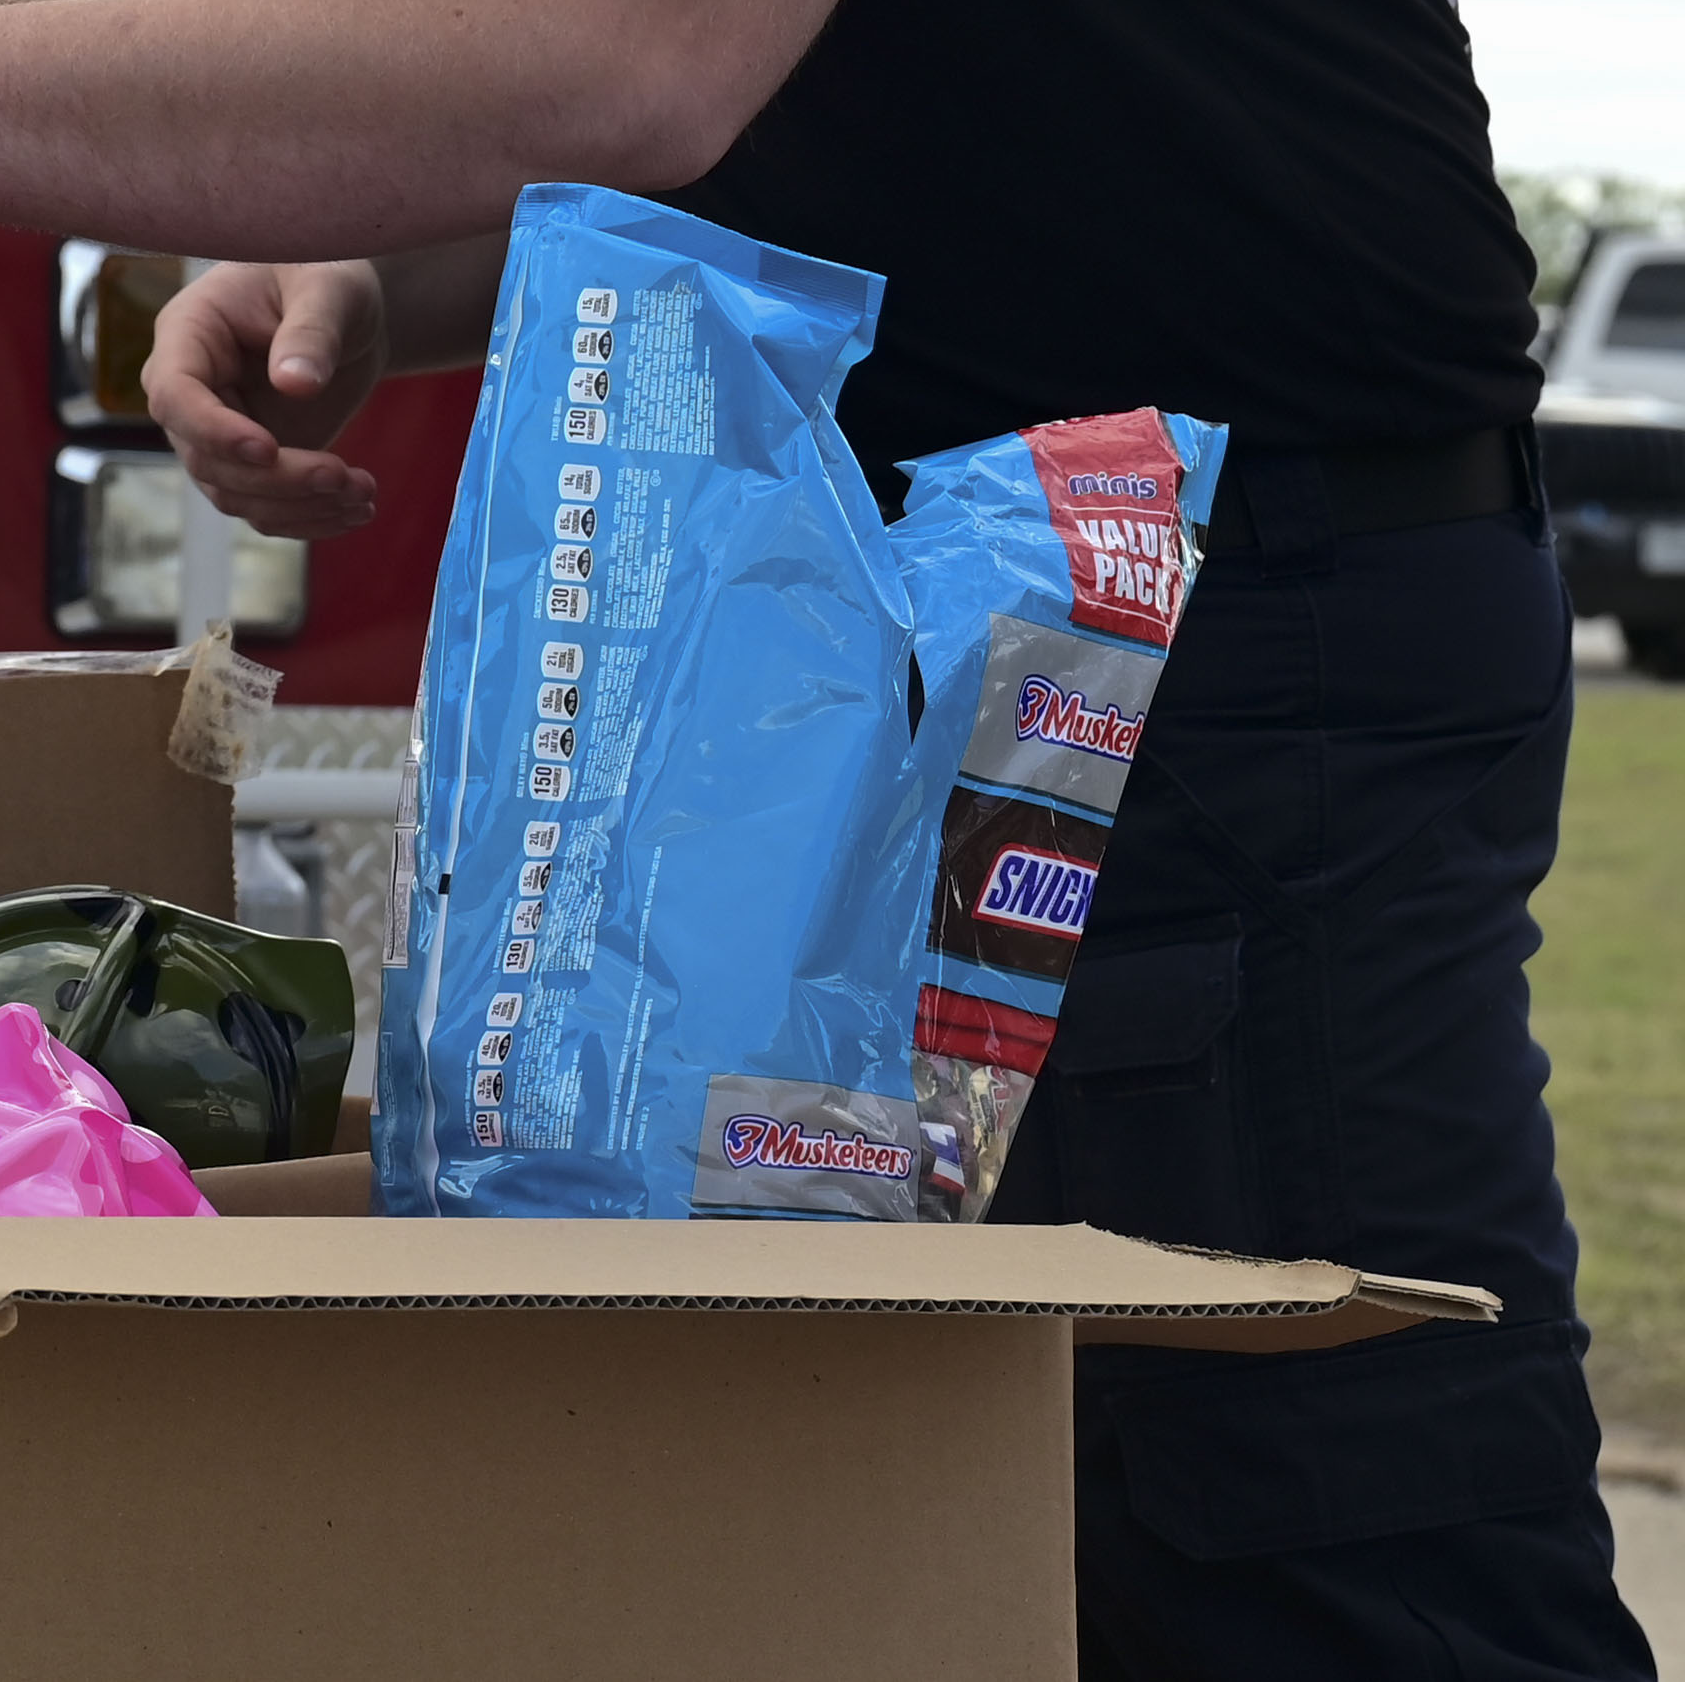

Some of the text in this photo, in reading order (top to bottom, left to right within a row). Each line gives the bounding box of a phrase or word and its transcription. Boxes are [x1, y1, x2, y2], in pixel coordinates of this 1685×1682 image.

[567, 410, 587, 438] 150
[1068, 472, 1158, 500] minis
[550, 588, 570, 615] 130
[1018, 687, 1047, 731] 3
[532, 766, 552, 795] 150
[506, 943, 522, 968] 130
[473, 1114, 493, 1142] 150
[727, 1124, 764, 1161] 3
[760, 1125, 911, 1176] Musketeers
